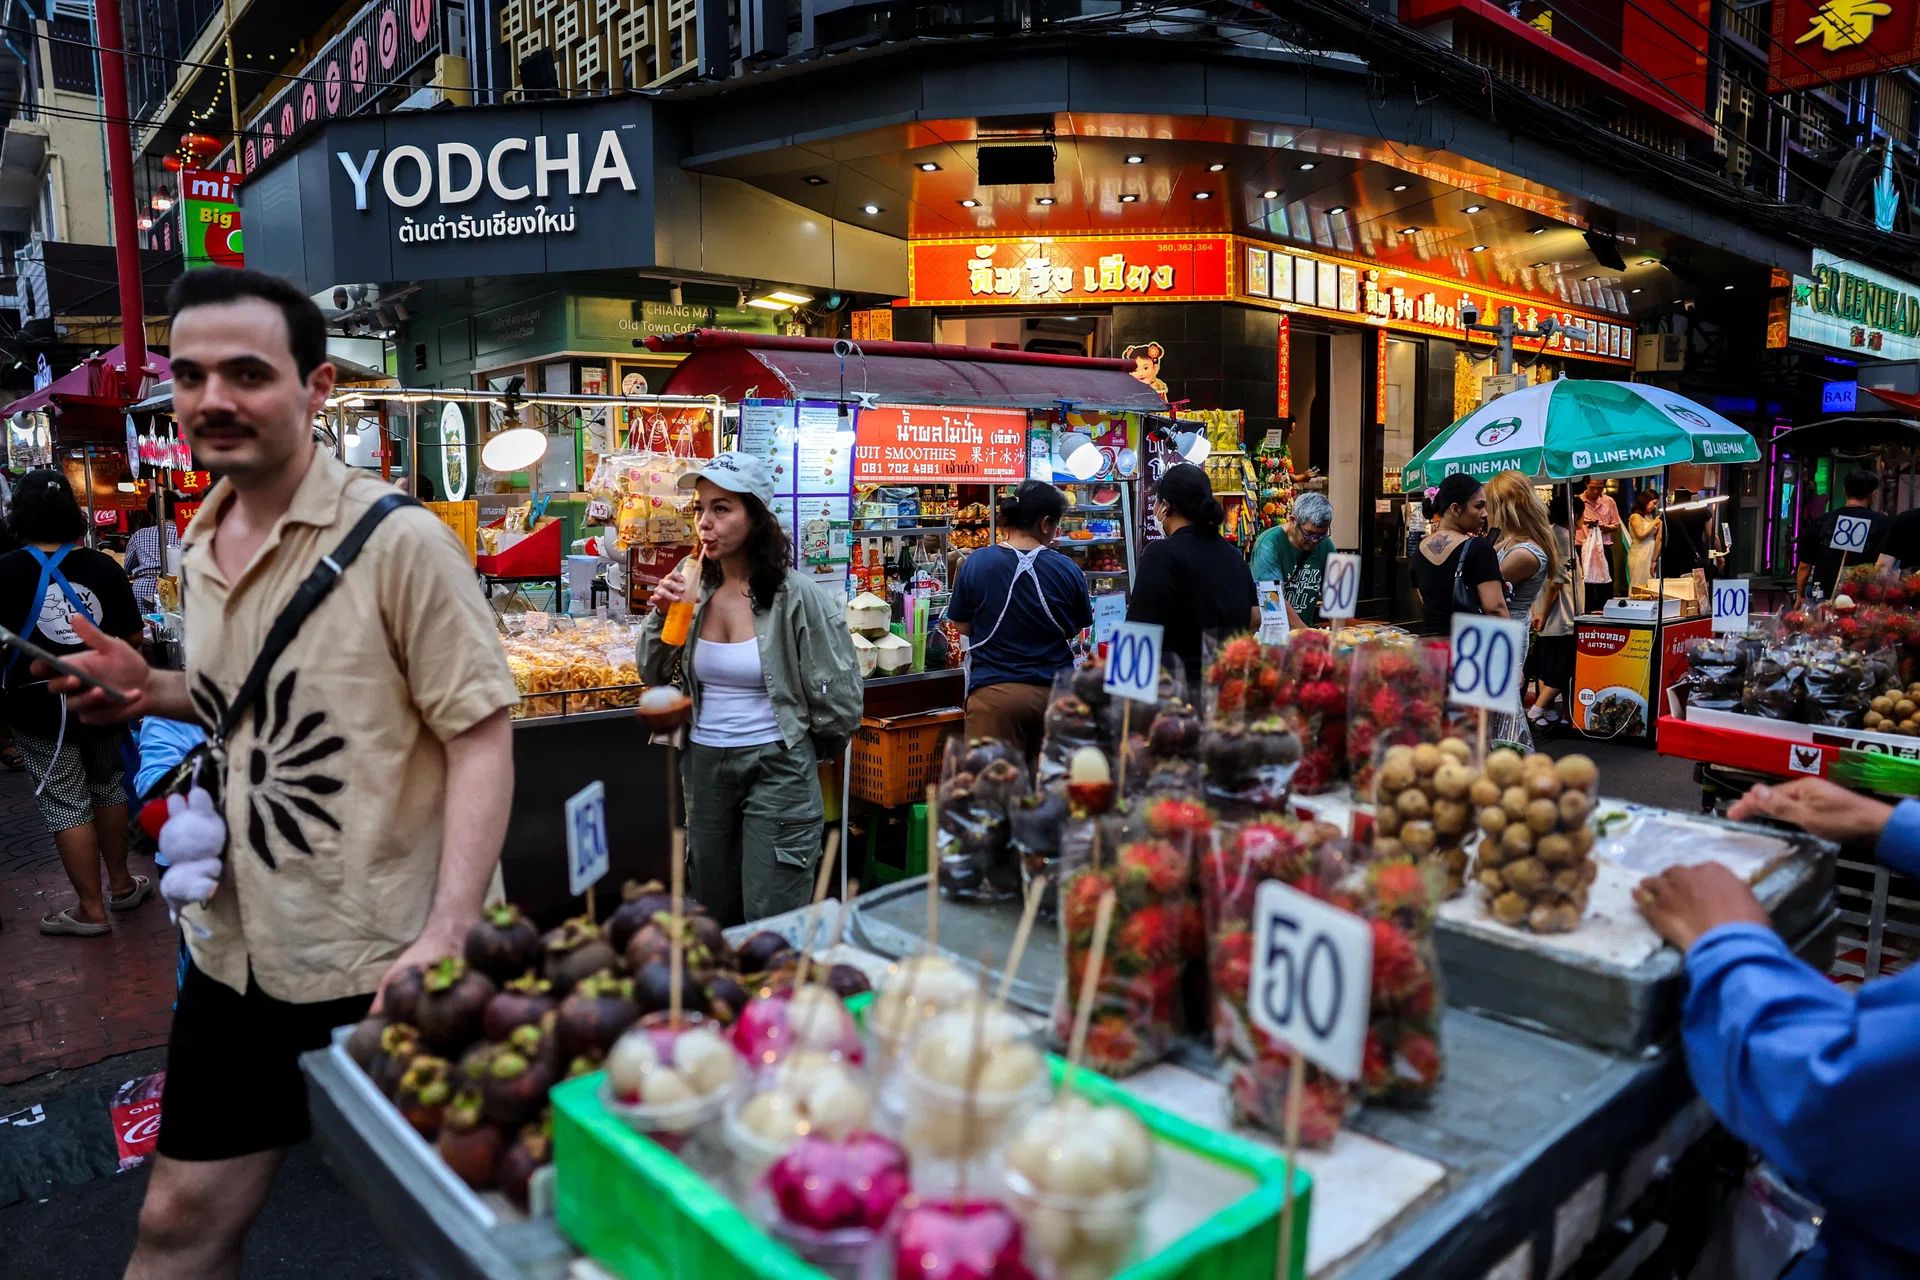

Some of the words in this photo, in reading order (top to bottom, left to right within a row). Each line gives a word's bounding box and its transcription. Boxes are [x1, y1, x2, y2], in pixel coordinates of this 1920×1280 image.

[337, 130, 637, 210] YODCHA
[192, 176, 234, 198] mi
[200, 208, 232, 229] Big
[399, 205, 576, 243] ต้นตำรับเชียงใหม่
[1157, 243, 1213, 252] 360,362,364
[646, 304, 690, 318] CHIANG
[692, 307, 713, 319] MAI
[618, 319, 638, 331] Old
[640, 321, 671, 333] Town
[673, 322, 707, 334] Coff
[1825, 391, 1852, 403] BAR
[896, 409, 983, 444] น้ำผลไม้ปั่น
[884, 447, 957, 461] SMOOTHIES
[971, 446, 1026, 465] 果汁冰沙
[861, 462, 883, 474] 081
[887, 462, 909, 474] 702
[941, 460, 979, 474] (เจ้าเก่า)
[1833, 519, 1868, 547] 80
[1323, 562, 1355, 613] 80
[68, 603, 93, 613] LK
[1713, 588, 1746, 618] 100
[1105, 632, 1154, 689] 100
[1453, 626, 1513, 698] 80
[1263, 913, 1344, 1042] 50
